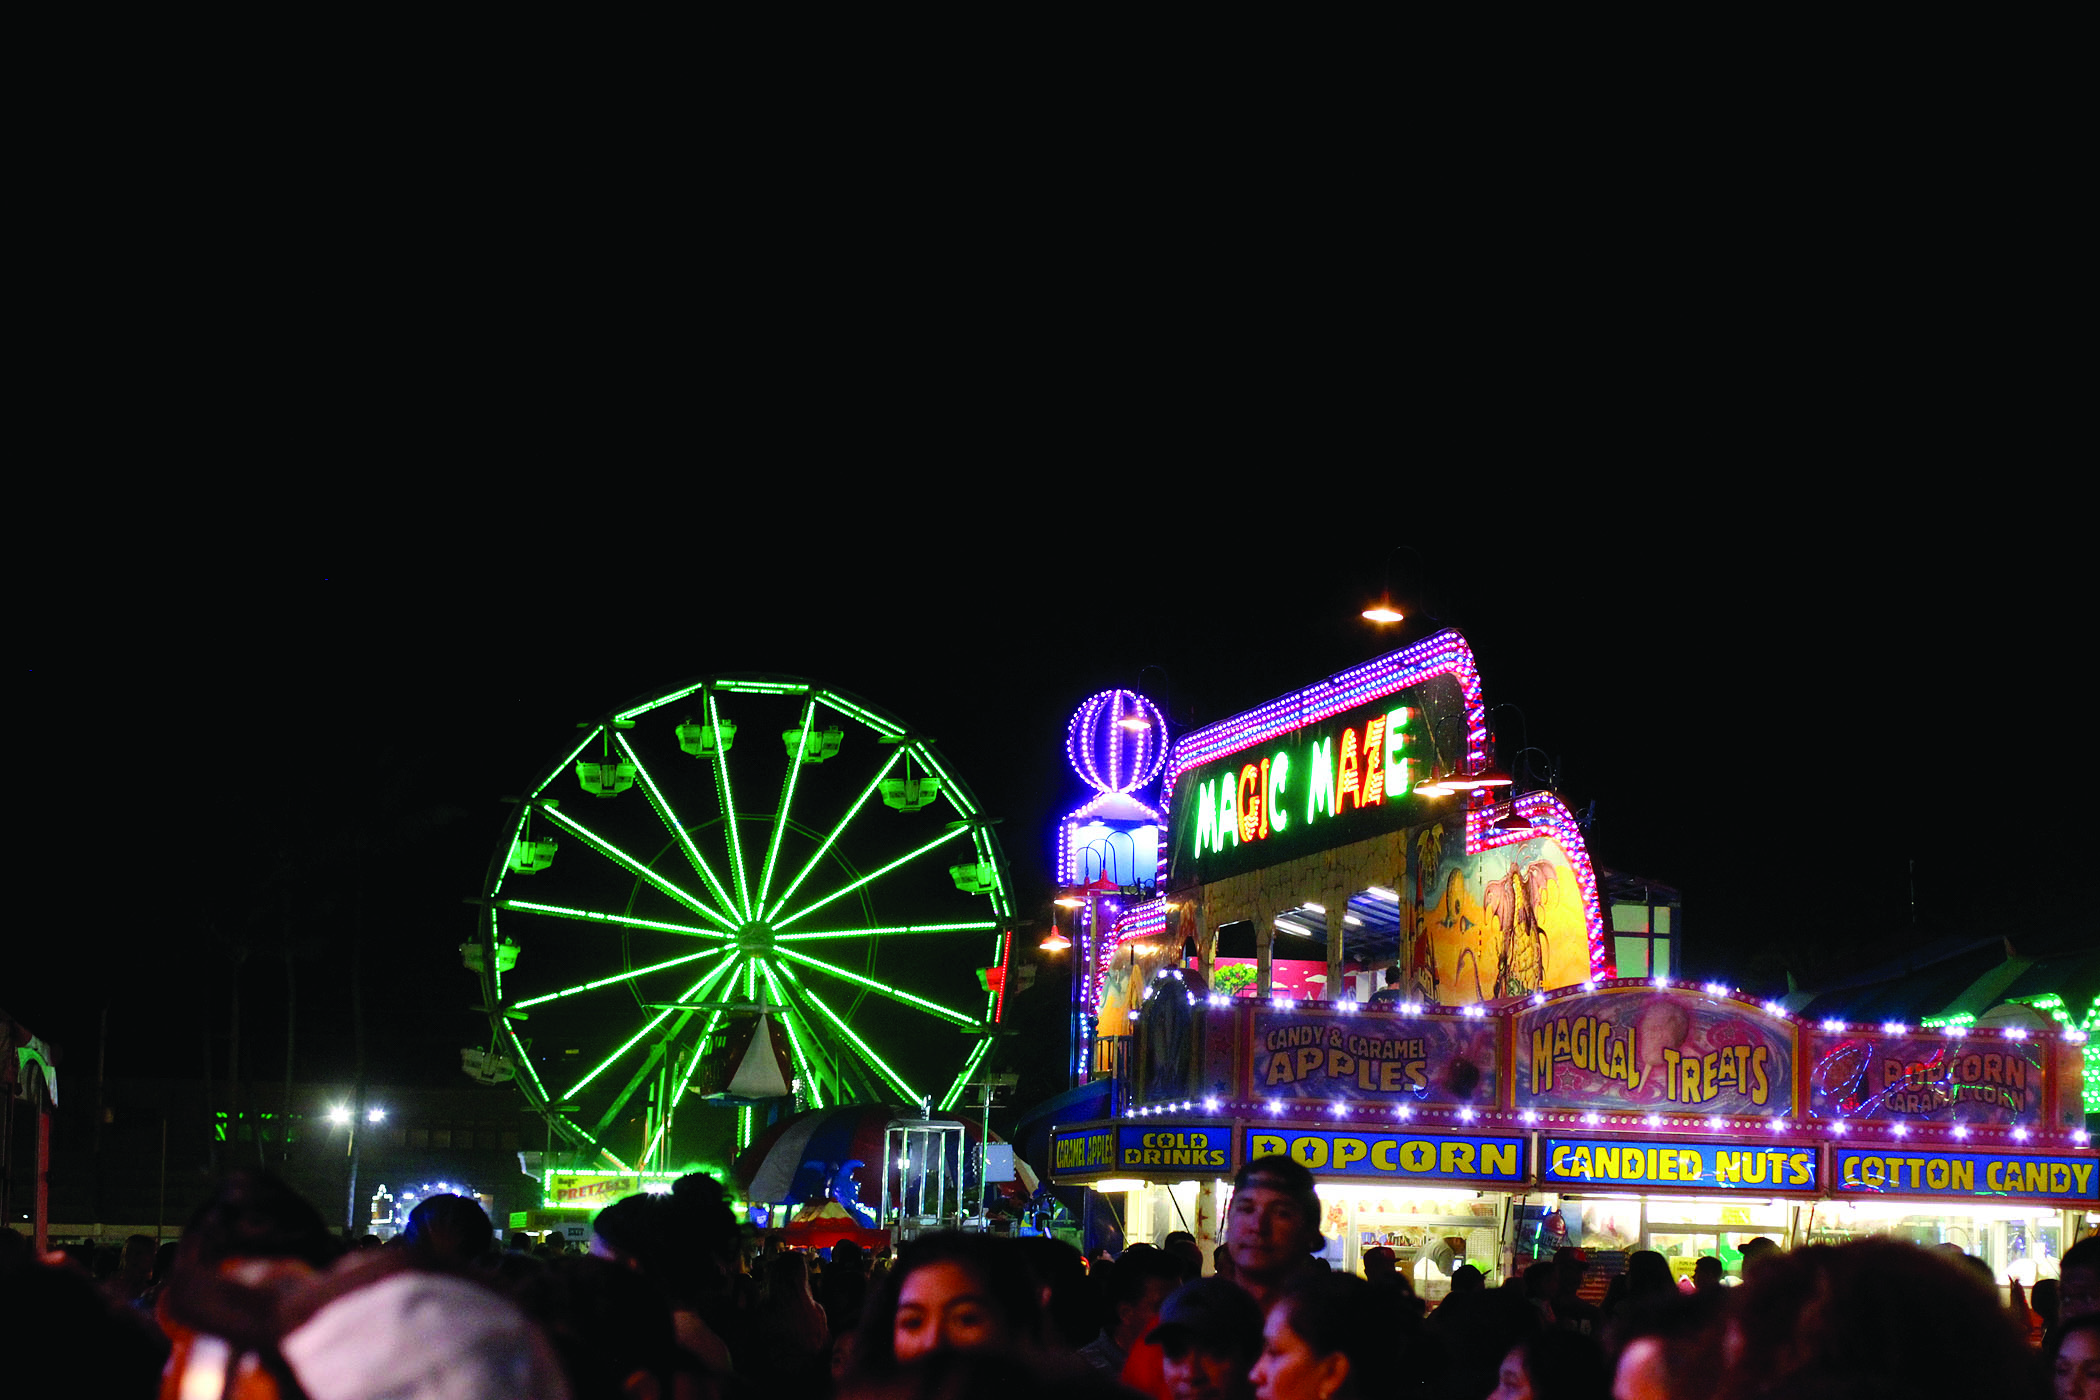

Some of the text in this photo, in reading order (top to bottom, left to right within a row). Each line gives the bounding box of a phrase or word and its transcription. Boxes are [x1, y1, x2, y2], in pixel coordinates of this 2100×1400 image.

[1195, 707, 1408, 859] MAGIC MAZE
[1266, 1025, 1426, 1060] CANDY & CARAMEL
[1531, 1016, 1769, 1105] MAGICAL TREATS
[1265, 1050, 1429, 1092] APPLES
[1883, 1053, 2026, 1092] POPCORN
[1056, 1133, 1113, 1169] CARAMEL APPLES
[1124, 1148, 1225, 1166] DRINKS
[1142, 1132, 1208, 1149] COLD
[1252, 1135, 1517, 1175] POPCORN
[1552, 1145, 1810, 1187] CANDIED NUTS
[1843, 1156, 2093, 1194] COTTON CANDY
